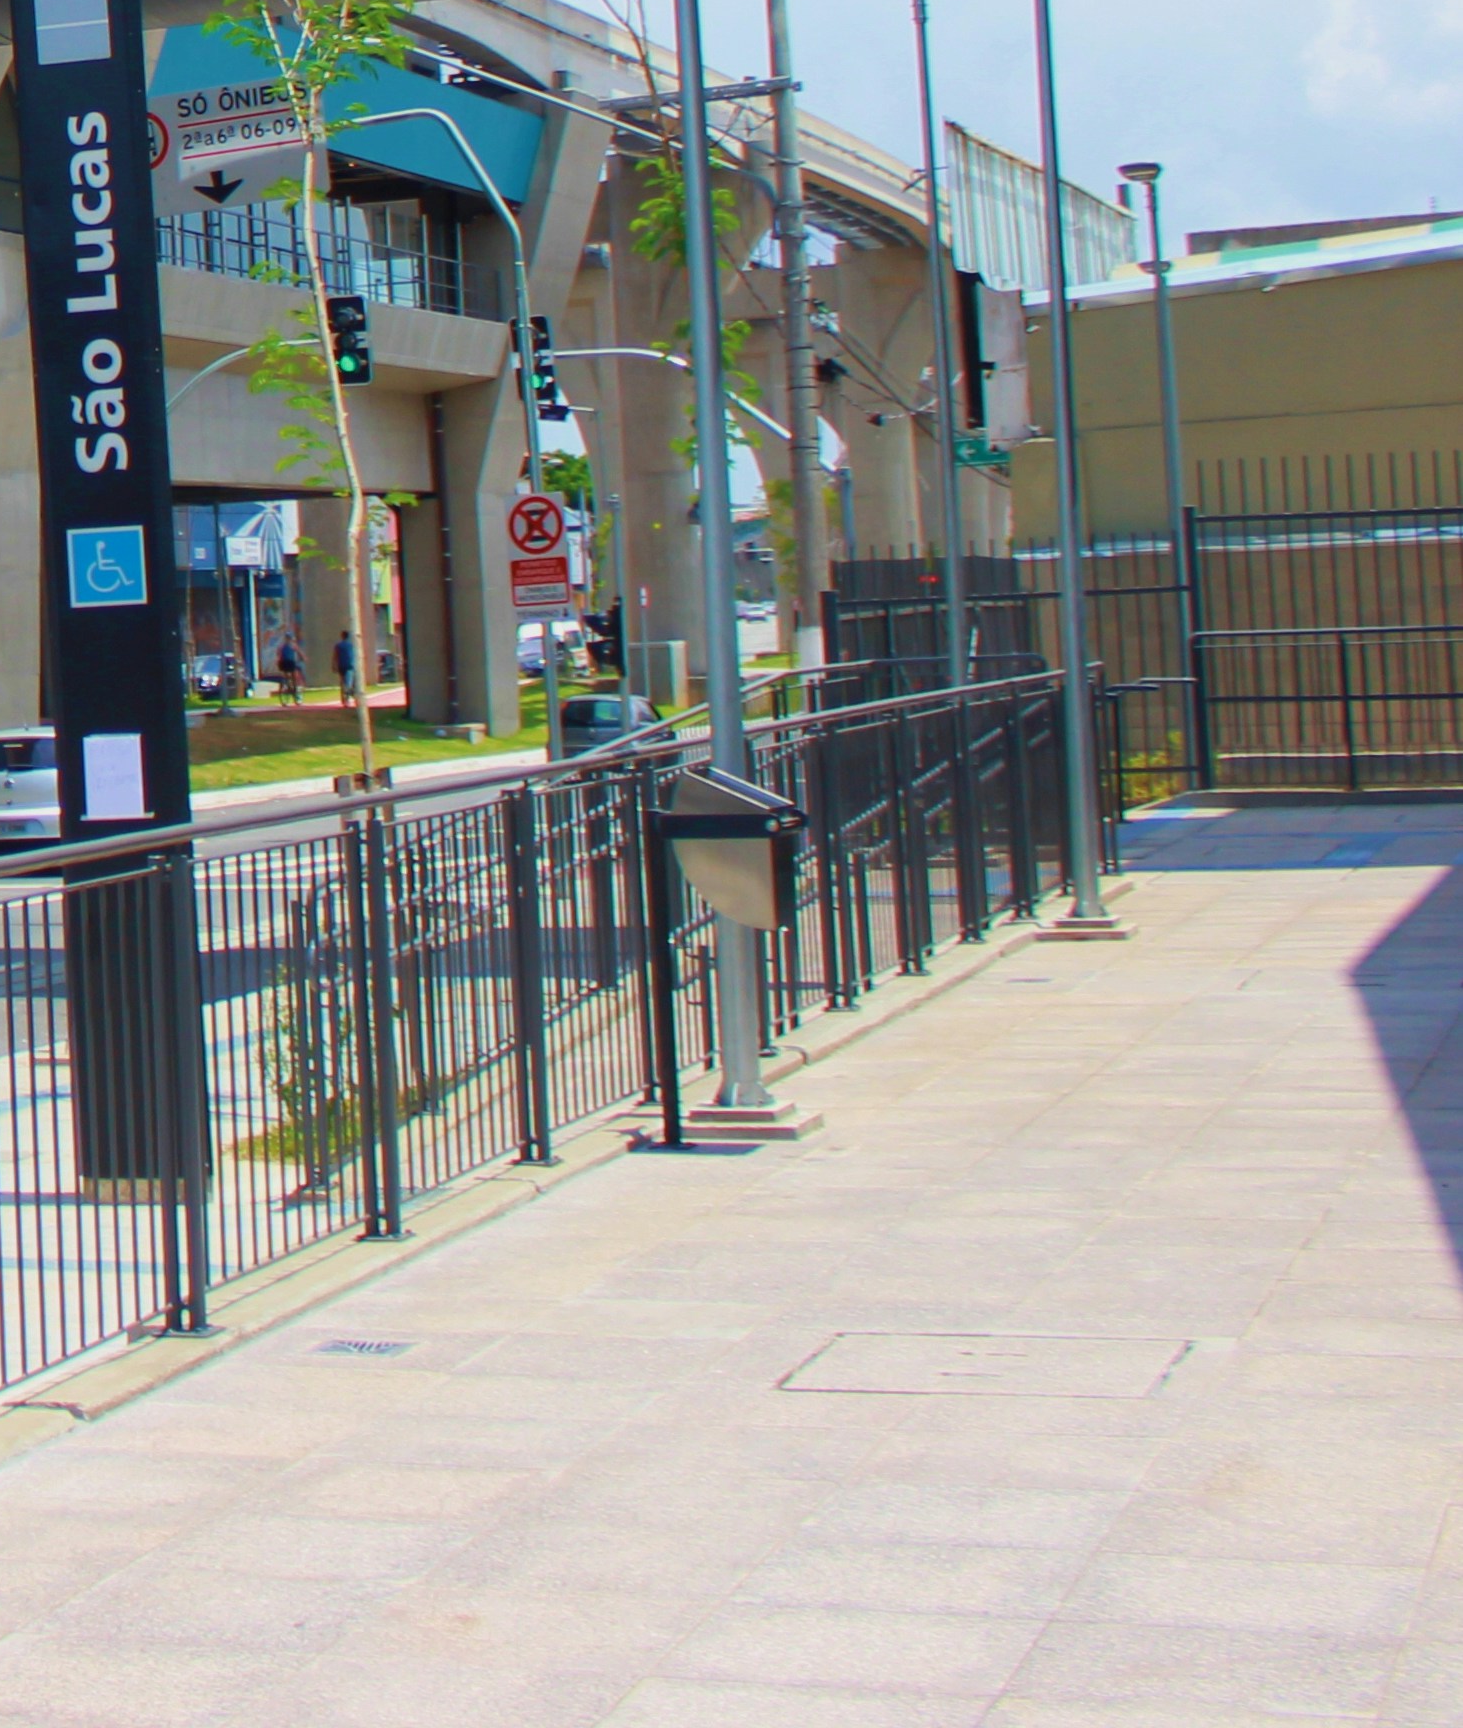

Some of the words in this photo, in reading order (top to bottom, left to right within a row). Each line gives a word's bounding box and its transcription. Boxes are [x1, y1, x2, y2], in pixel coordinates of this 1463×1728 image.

[177, 92, 207, 118] SÓ
[67, 111, 118, 313] Lucas
[71, 338, 128, 473] São
